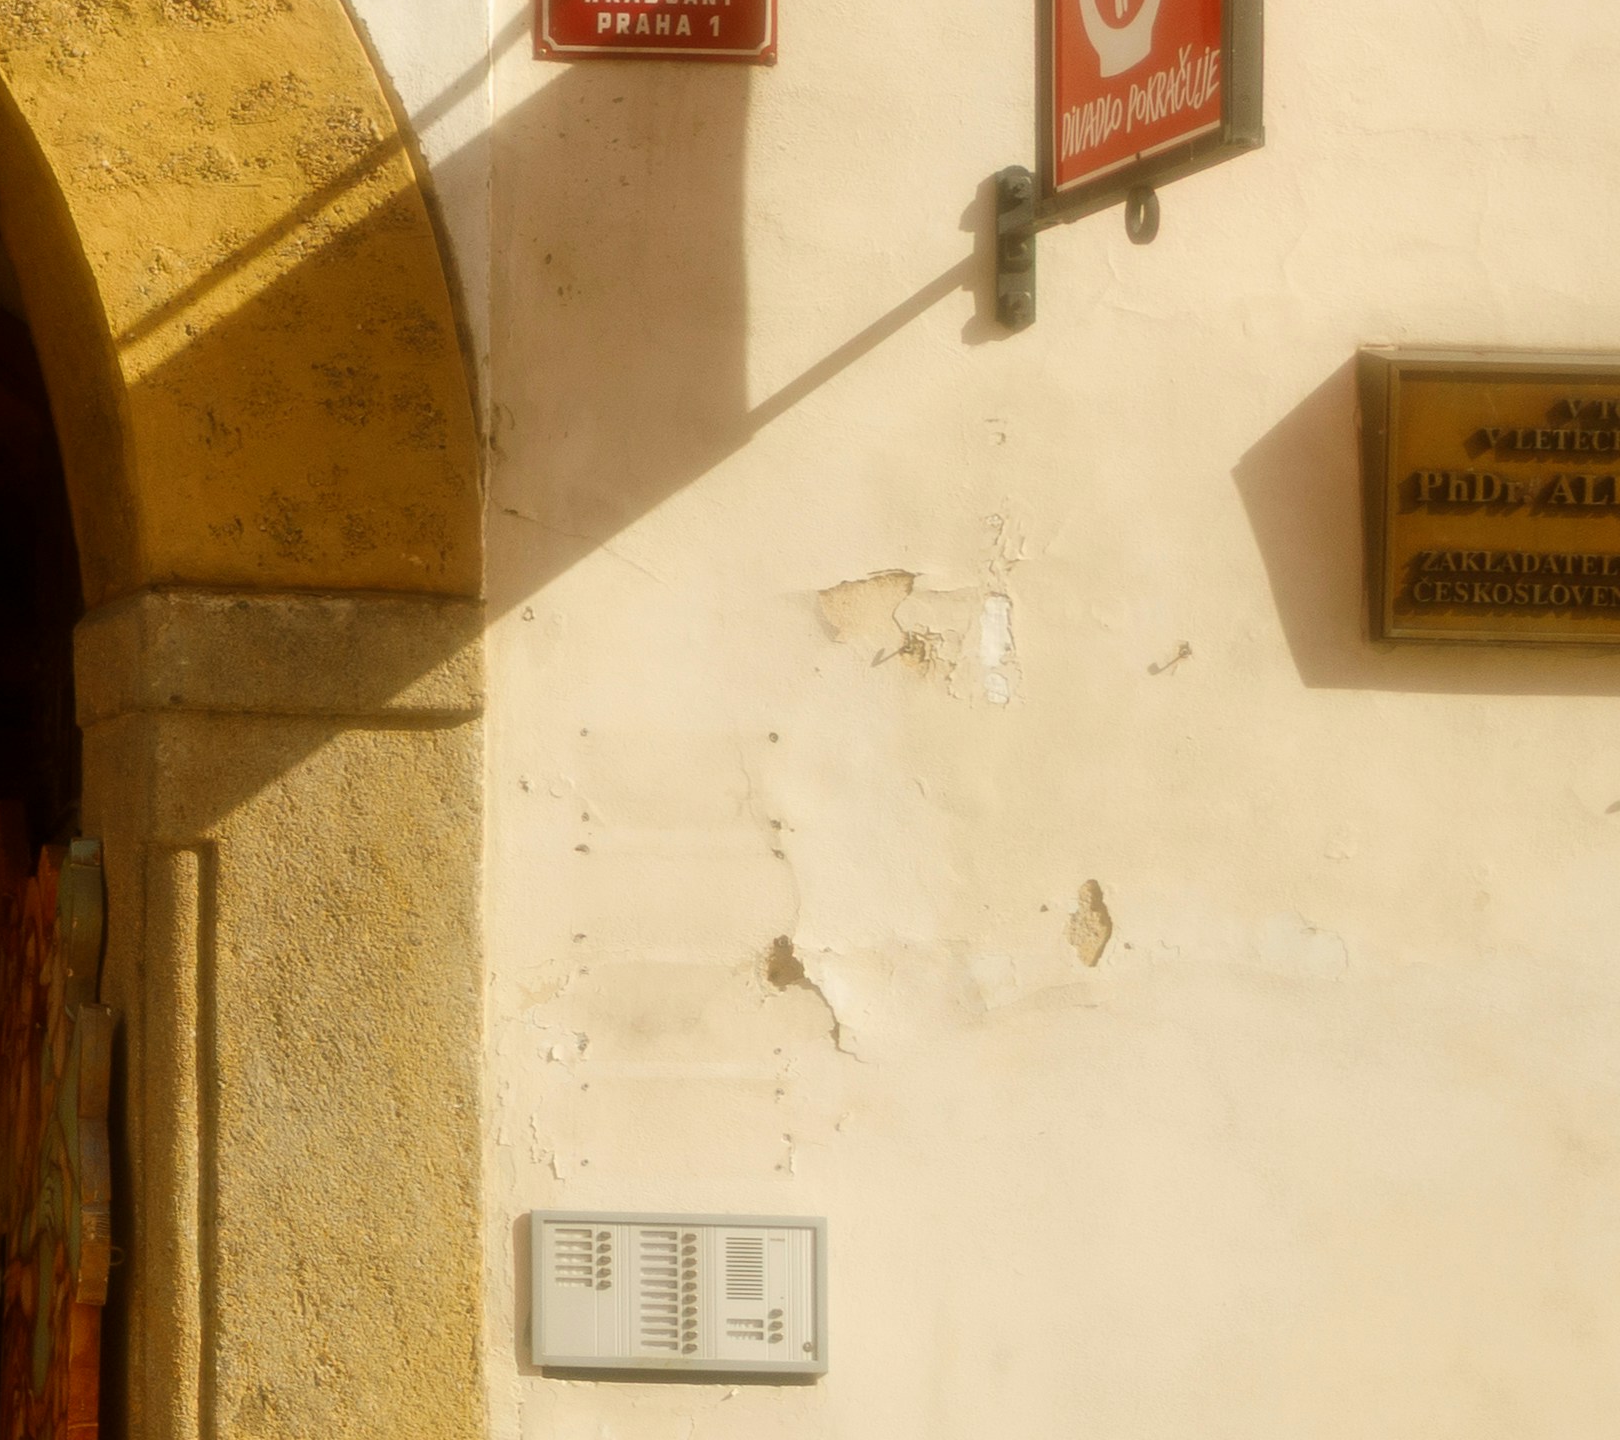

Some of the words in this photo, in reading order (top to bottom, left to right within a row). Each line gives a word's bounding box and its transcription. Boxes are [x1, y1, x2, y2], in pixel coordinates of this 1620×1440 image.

[597, 12, 692, 36] PRAHA
[709, 15, 720, 37] 1
[1566, 398, 1582, 419] V
[1483, 427, 1501, 449] V
[1417, 470, 1529, 504] PhDr.
[1421, 550, 1618, 577] ZAKLADATEL
